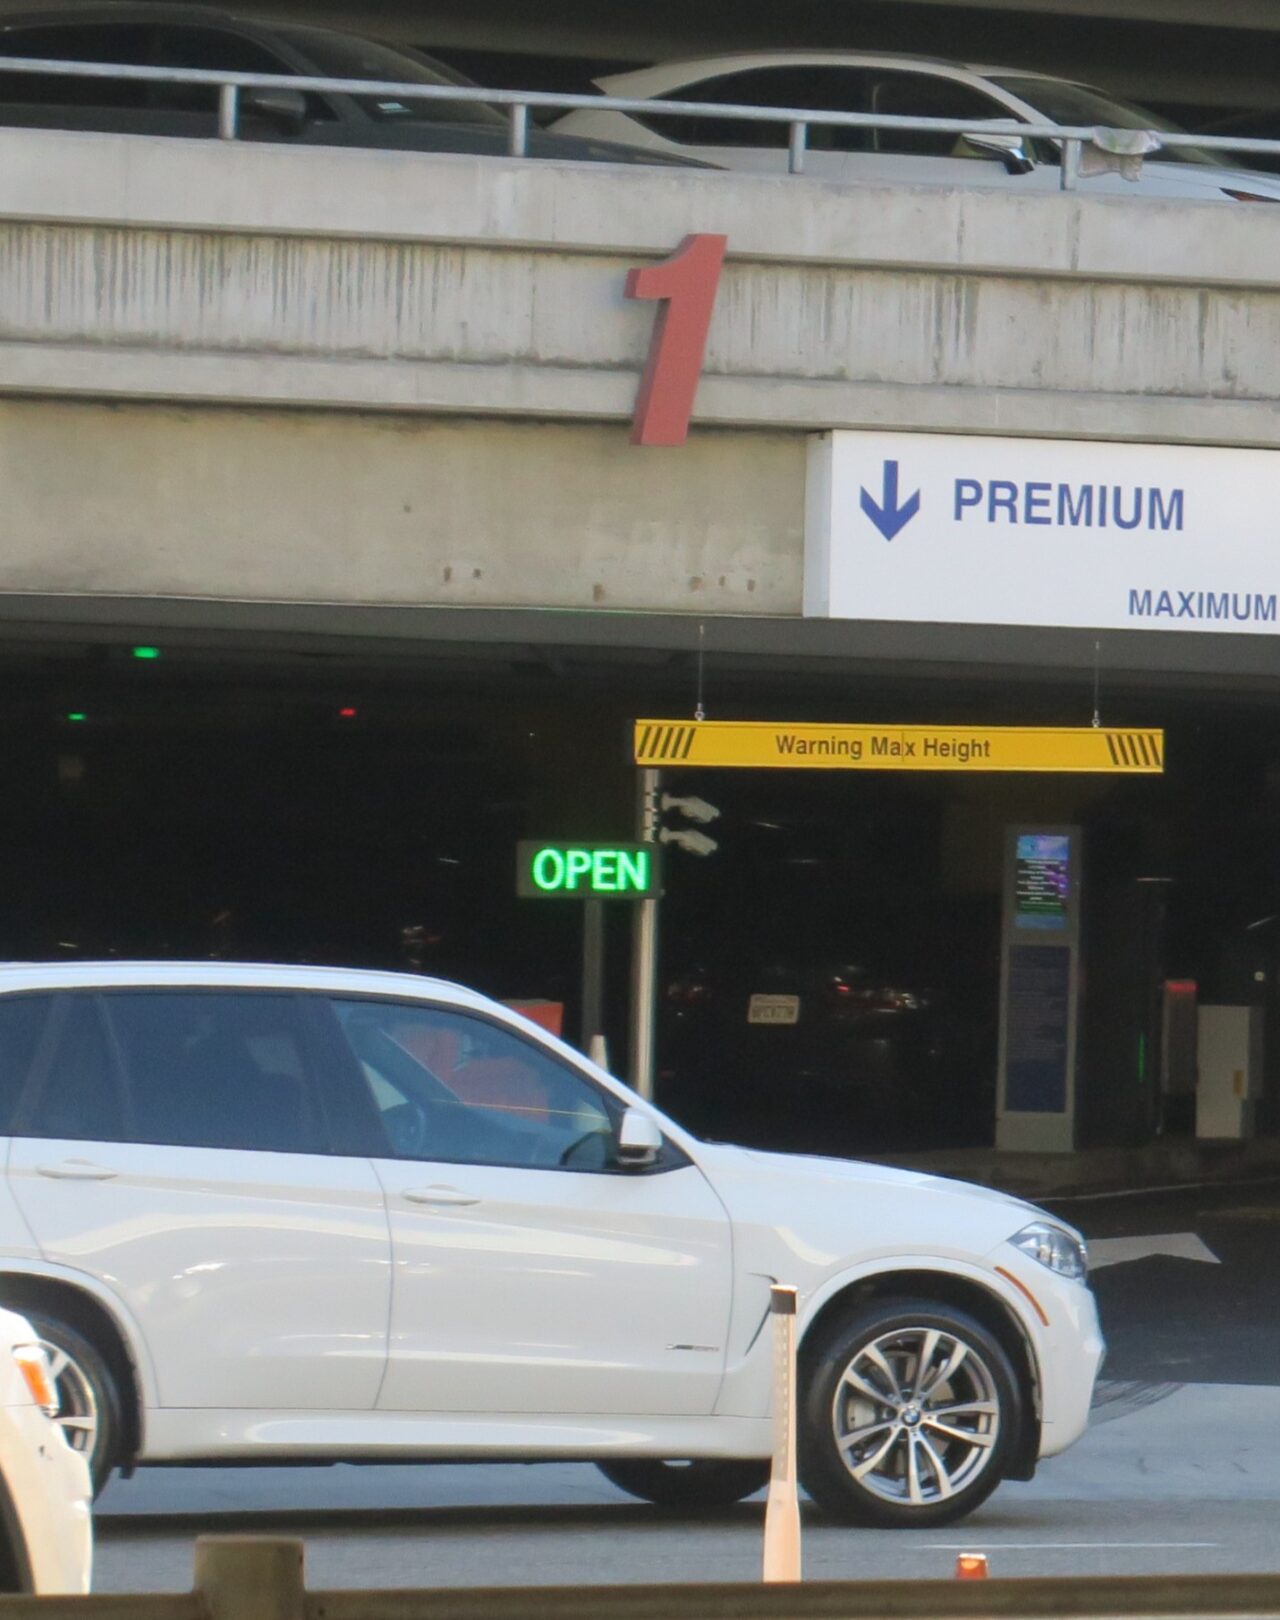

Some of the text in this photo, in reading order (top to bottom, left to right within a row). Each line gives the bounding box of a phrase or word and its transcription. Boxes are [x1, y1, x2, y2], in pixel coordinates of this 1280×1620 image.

[624, 233, 728, 446] 1
[954, 478, 1184, 531] PREMIUM
[1129, 589, 1277, 621] MAXIMUM
[775, 734, 991, 763] Warning Max Height
[532, 848, 647, 890] OPEN
